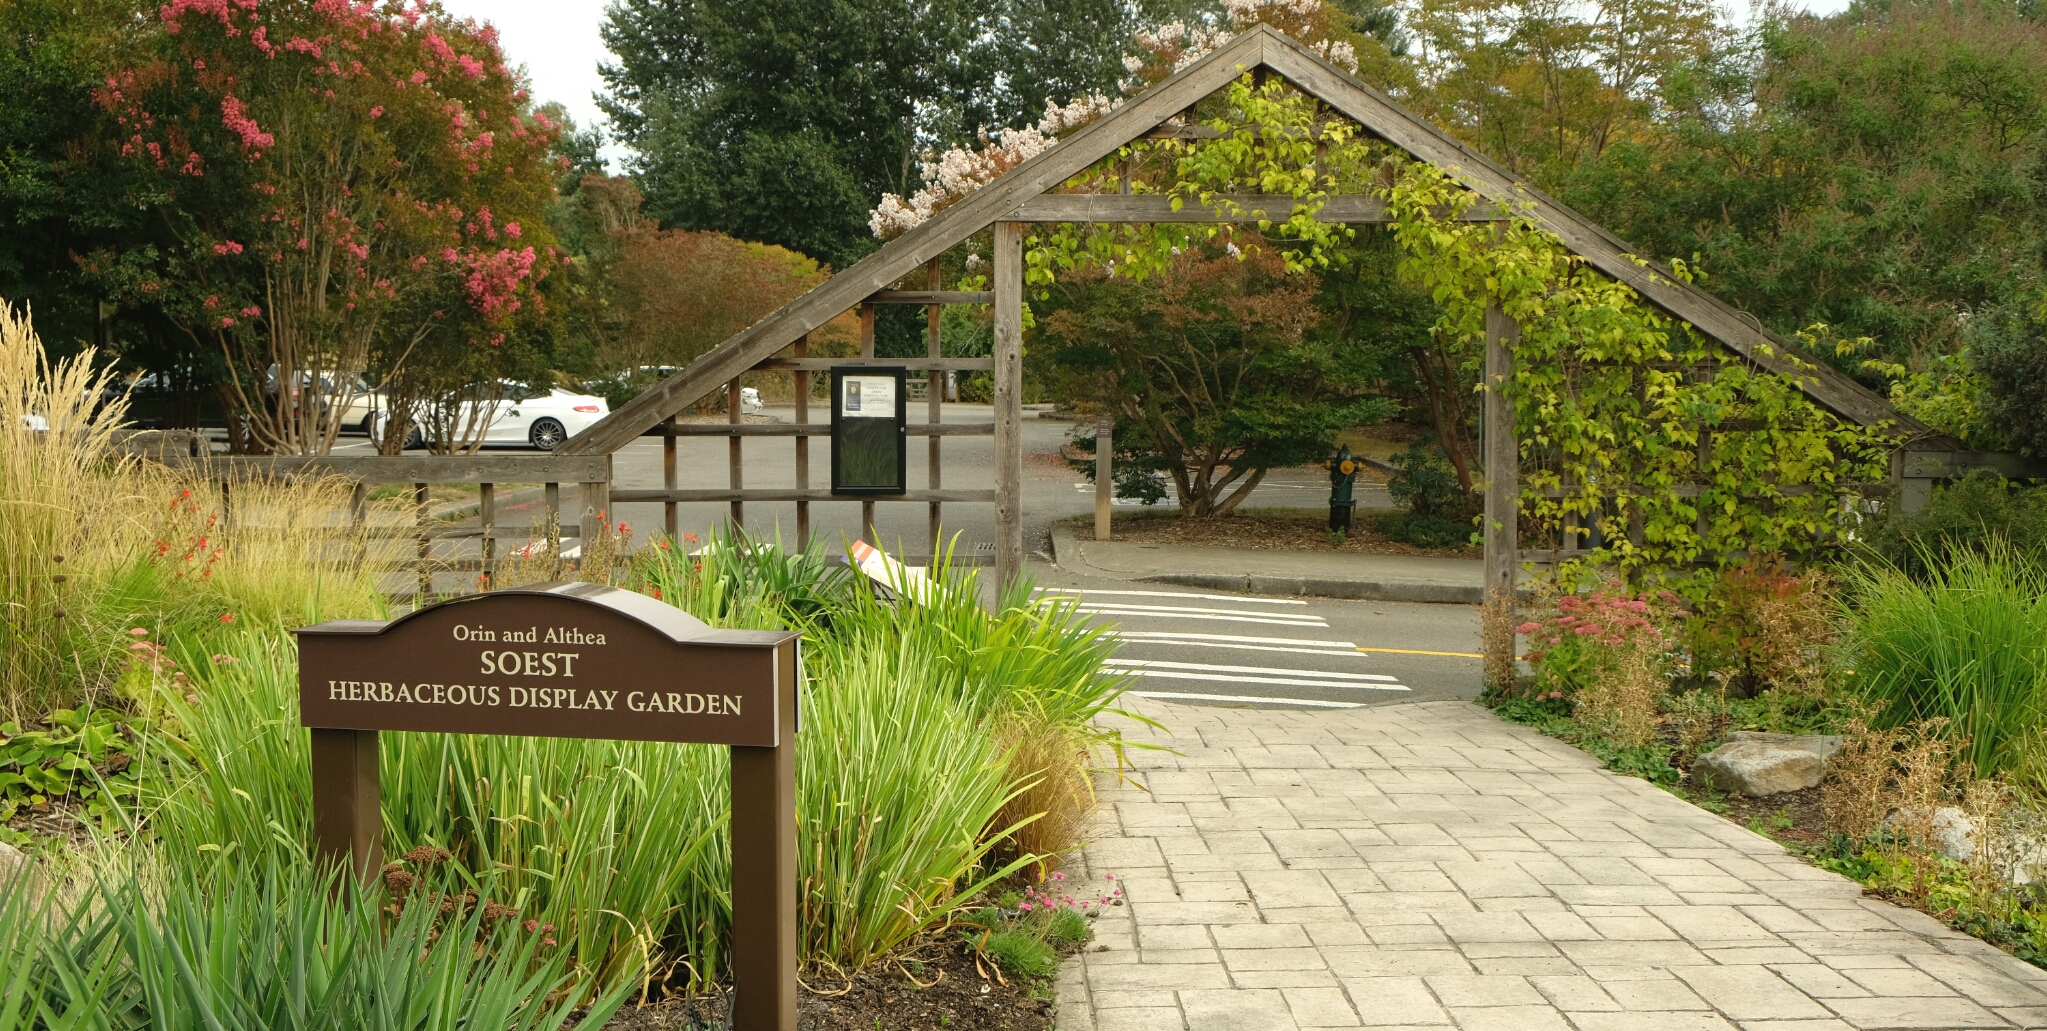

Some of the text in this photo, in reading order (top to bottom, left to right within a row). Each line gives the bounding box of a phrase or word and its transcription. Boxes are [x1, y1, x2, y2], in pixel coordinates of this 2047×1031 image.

[453, 625, 606, 645] Orin and Althea
[481, 651, 579, 677] SOEST
[329, 681, 742, 715] HERBACEOUS DISPLAY GARDEN
